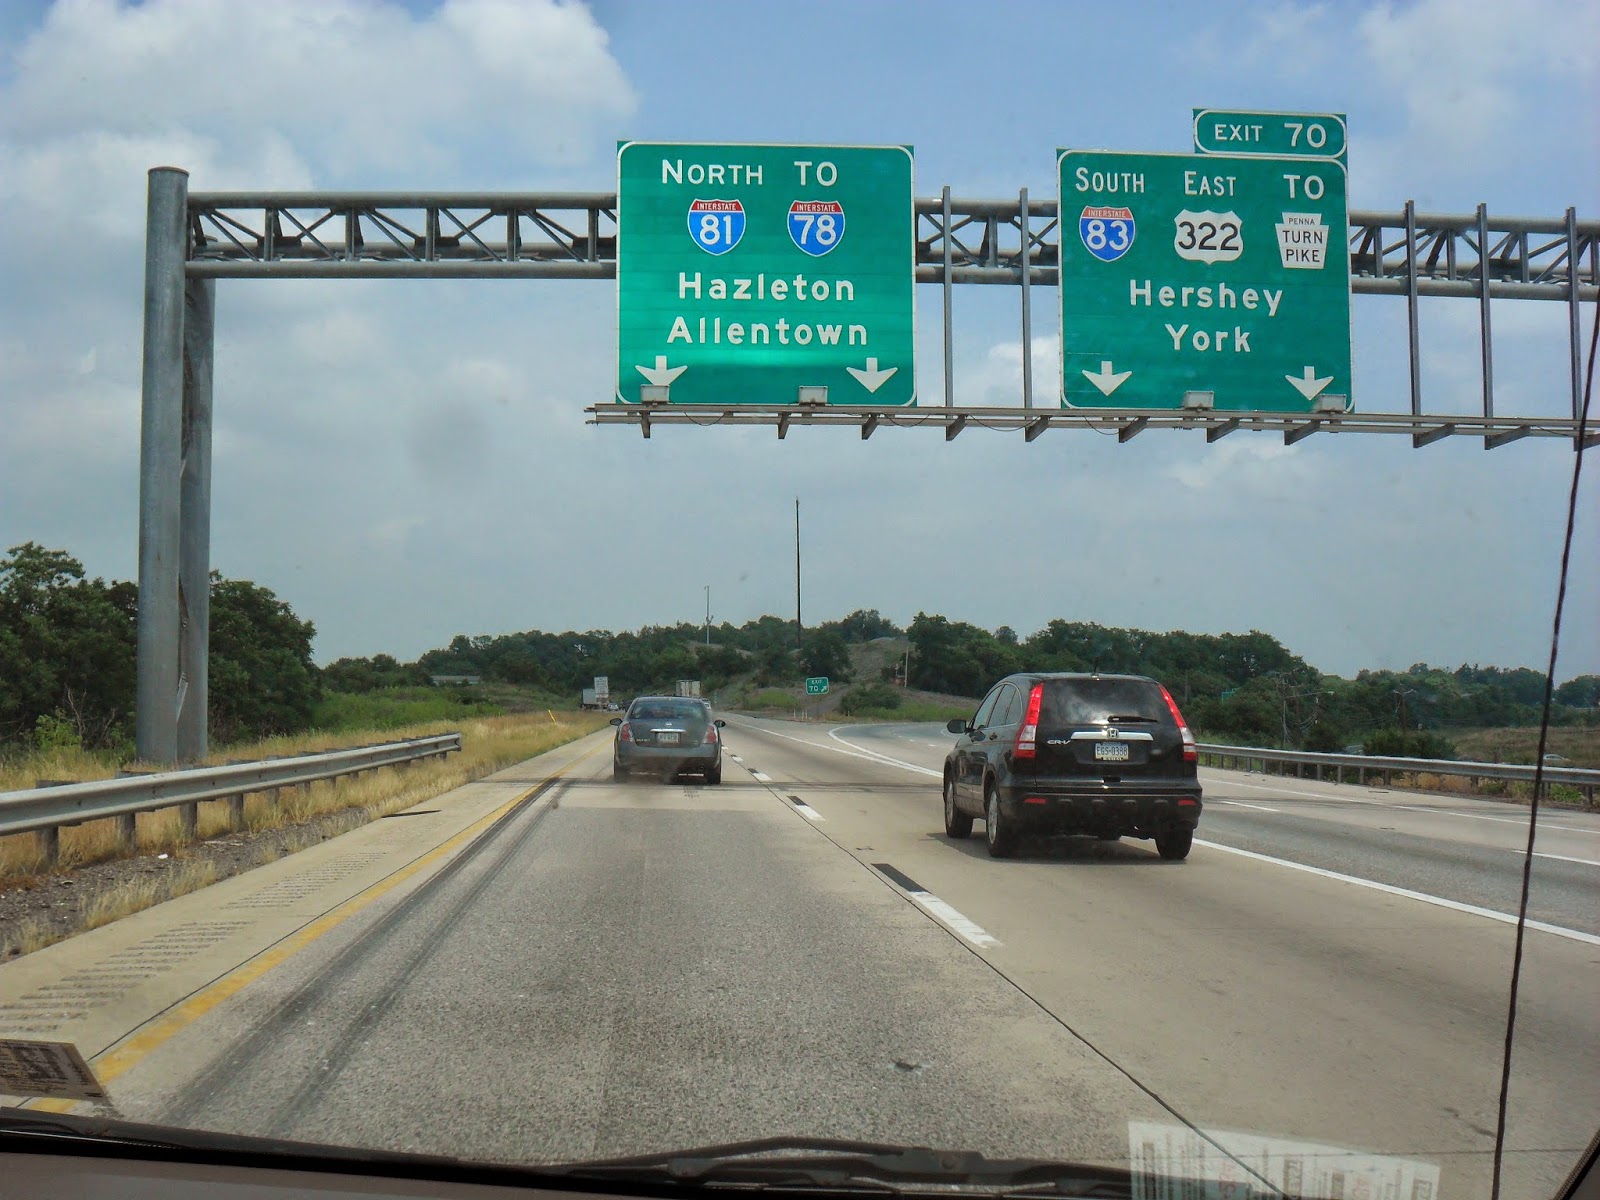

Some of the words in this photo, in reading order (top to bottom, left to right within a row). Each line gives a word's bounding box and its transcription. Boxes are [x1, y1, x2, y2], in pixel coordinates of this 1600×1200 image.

[1214, 124, 1262, 141] EXIT
[1284, 123, 1327, 148] 70
[662, 159, 763, 185] NORTH
[794, 161, 837, 186] TO
[1075, 167, 1145, 193] SOUTH
[1184, 170, 1237, 196] EAST
[1283, 174, 1325, 199] TO
[697, 202, 736, 211] INTERSTATE
[796, 204, 835, 212] INTERSTATE
[1088, 209, 1126, 218] INTERSTATE
[700, 214, 732, 245] 81
[794, 215, 837, 246] 78
[1288, 217, 1315, 225] PENNA
[1086, 219, 1129, 251] 83
[1178, 221, 1239, 250] 322
[1282, 229, 1323, 244] TURN
[1286, 249, 1320, 262] PIKE
[678, 272, 855, 301] Hazleton
[1129, 279, 1283, 317] Hershey
[666, 316, 868, 345] Allentown
[1164, 323, 1251, 352] York
